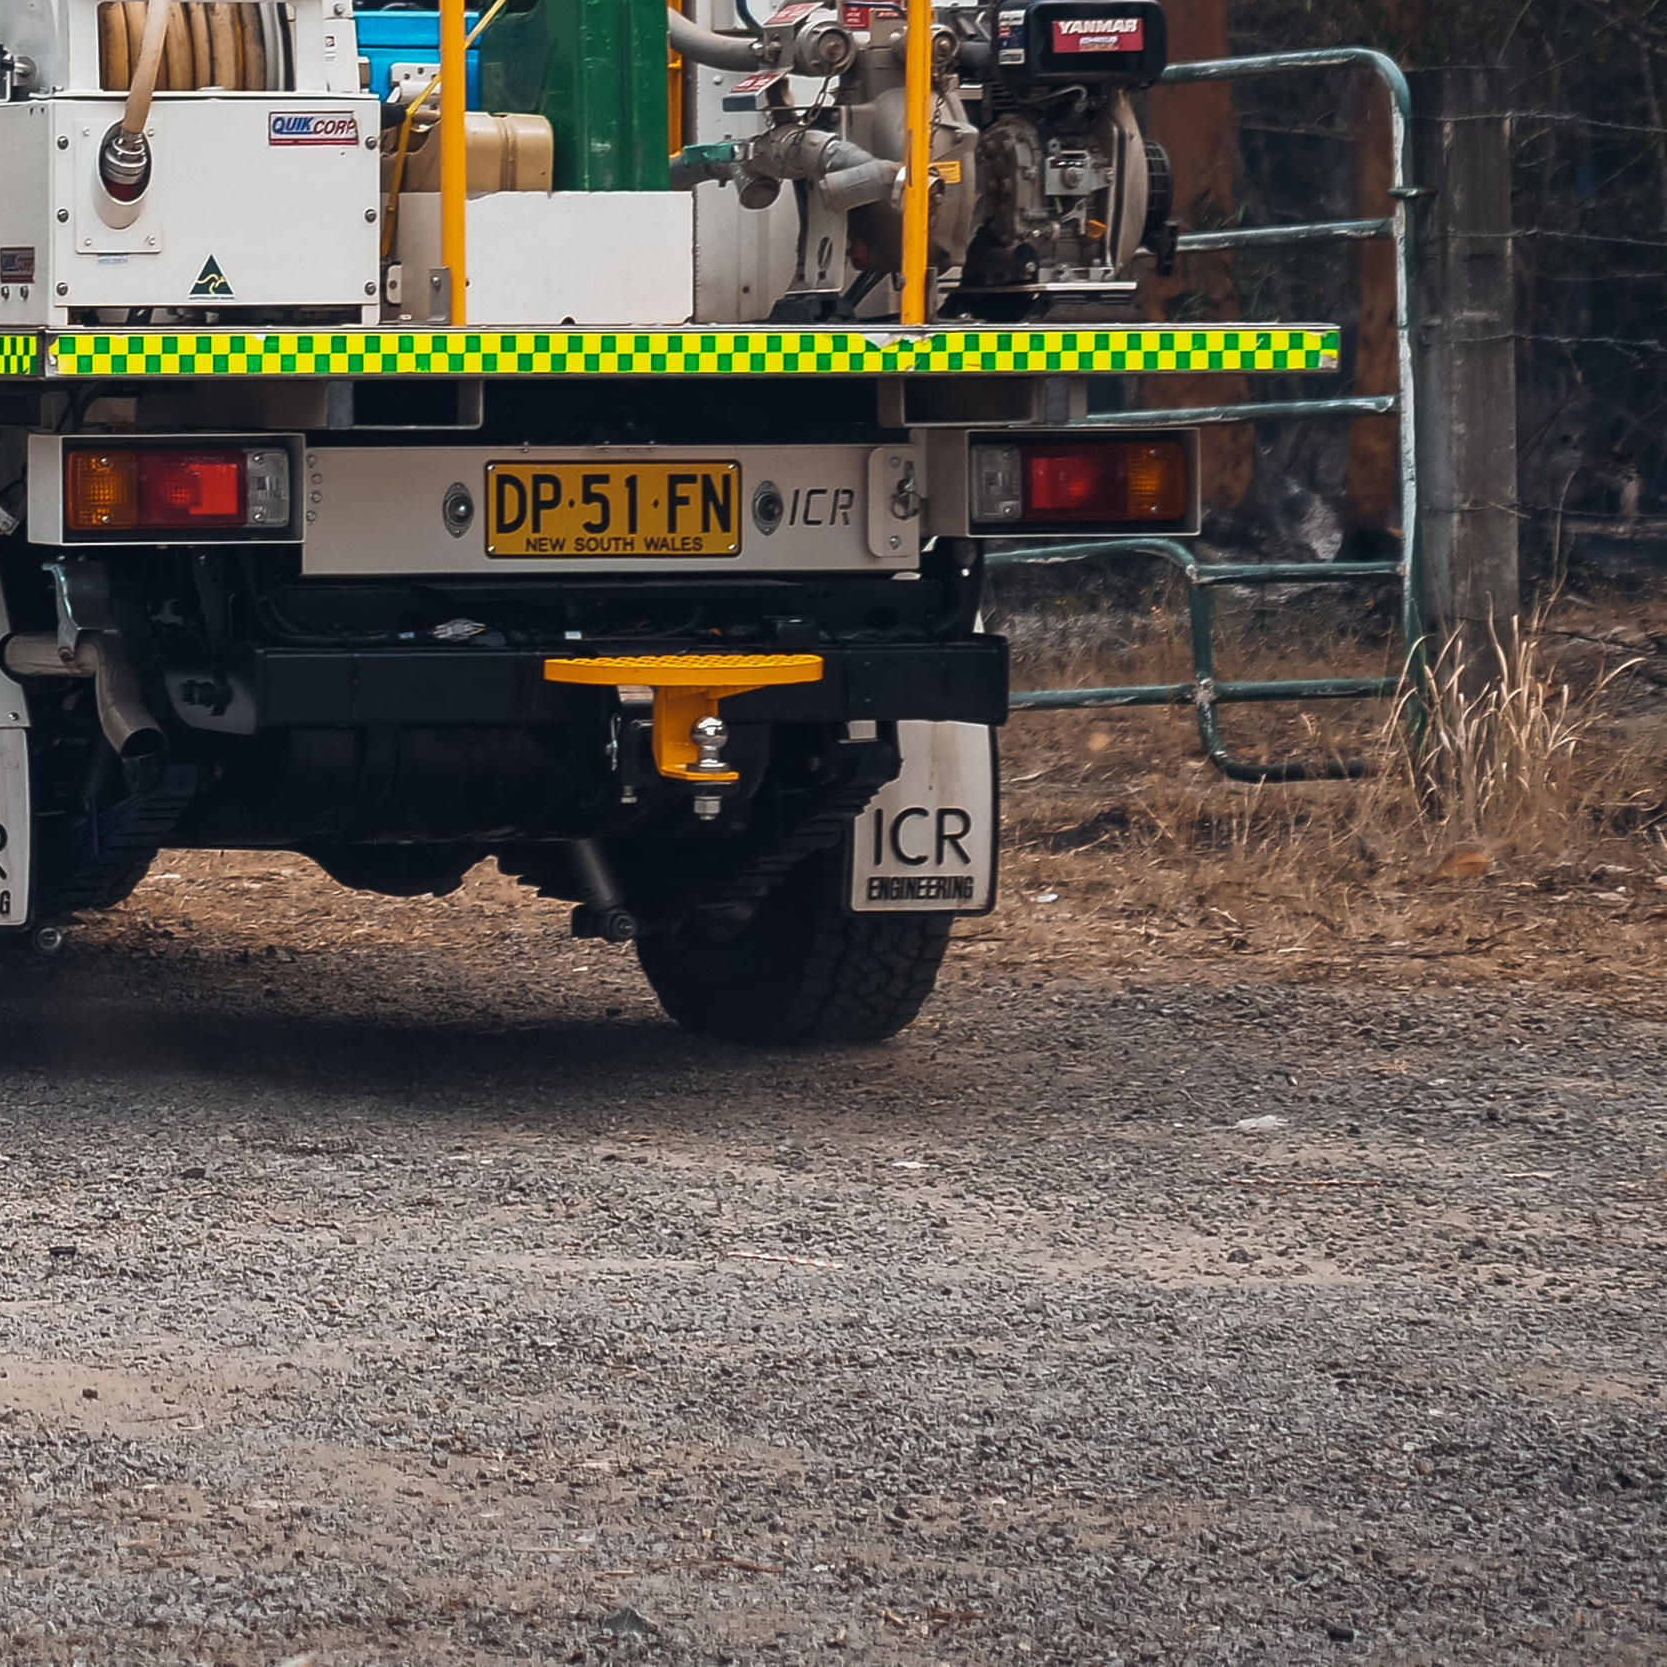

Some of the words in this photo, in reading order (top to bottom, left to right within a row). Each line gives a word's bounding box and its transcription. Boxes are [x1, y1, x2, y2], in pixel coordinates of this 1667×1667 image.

[1058, 19, 1138, 34] YANMAR
[788, 488, 855, 526] ICR
[525, 537, 566, 552] NEW
[574, 537, 635, 552] SOUTH
[644, 536, 703, 552] WALES
[875, 807, 971, 866] ICR
[868, 876, 974, 900] ENGINEERING
